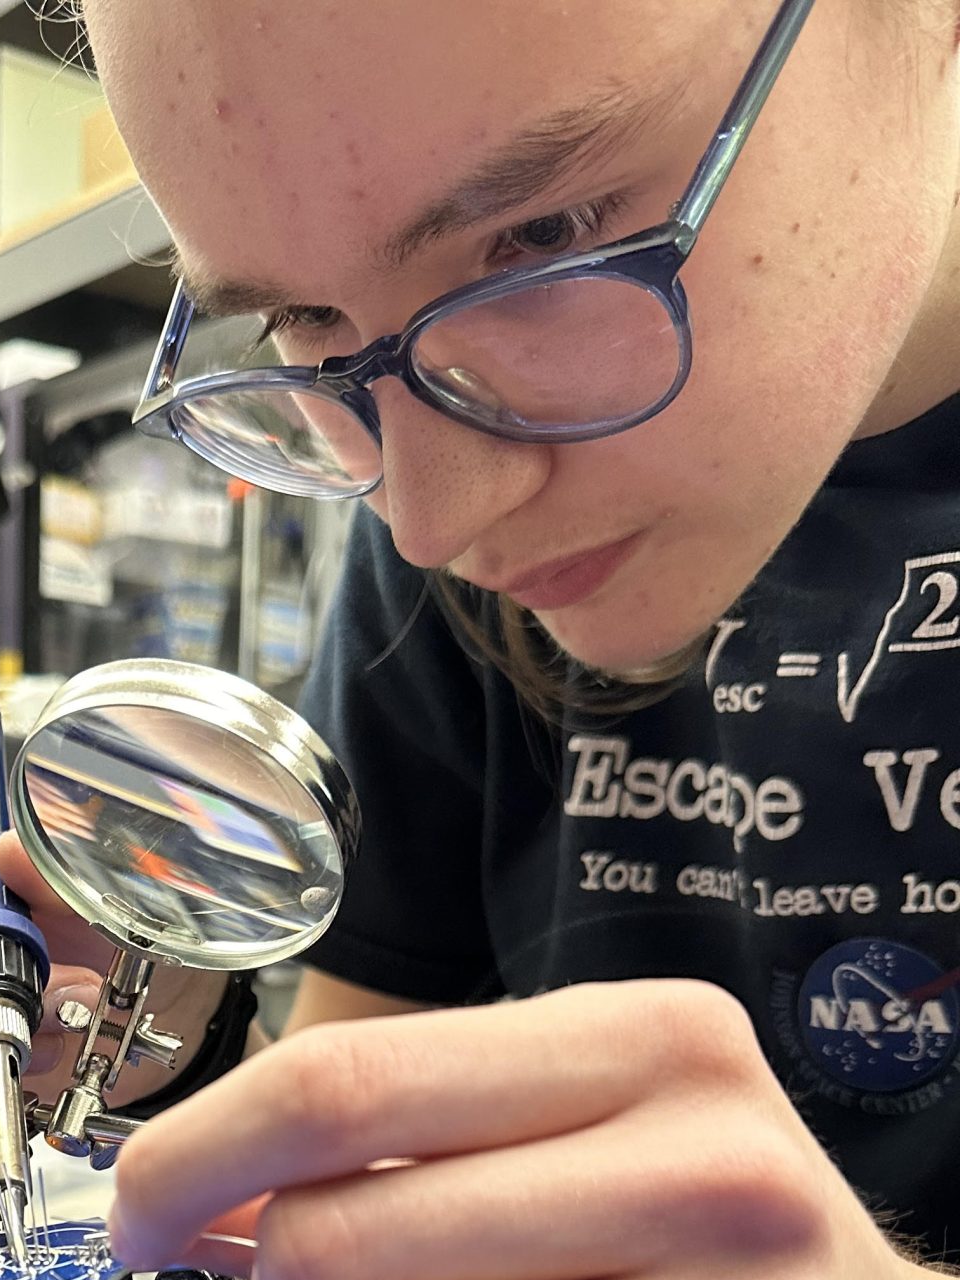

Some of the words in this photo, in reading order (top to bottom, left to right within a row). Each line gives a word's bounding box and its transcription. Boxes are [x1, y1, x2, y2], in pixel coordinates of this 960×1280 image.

[713, 684, 767, 713] esc
[563, 733, 803, 853] Escape
[579, 852, 656, 894] You
[676, 865, 749, 908] can'
[753, 878, 878, 916] leave
[809, 994, 952, 1034] NASA
